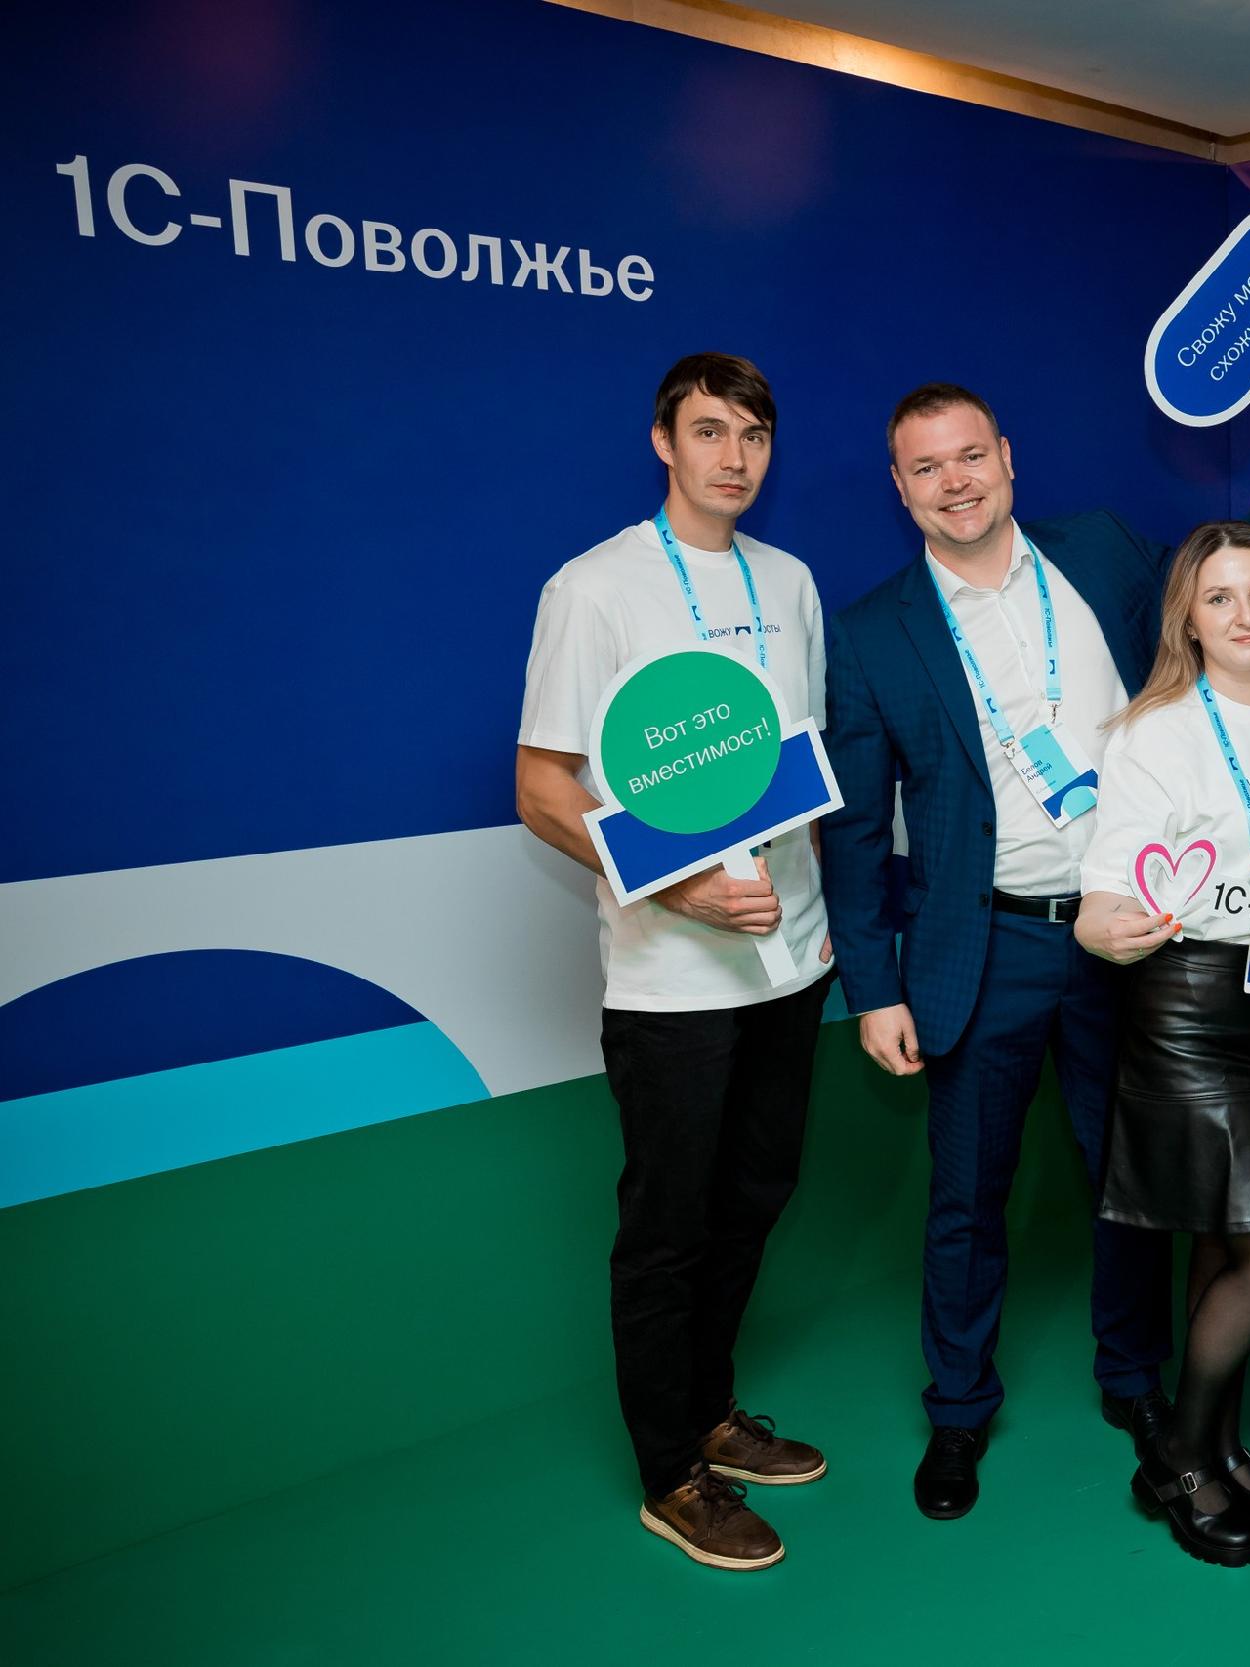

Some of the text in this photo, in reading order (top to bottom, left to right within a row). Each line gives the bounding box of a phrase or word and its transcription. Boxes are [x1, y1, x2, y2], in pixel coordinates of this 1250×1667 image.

[56, 154, 655, 302] 1С-Поволжье
[1177, 303, 1236, 367] Свожу
[708, 627, 731, 639] ВОЖУ
[628, 717, 771, 794] вместимост!
[644, 704, 730, 749] Вот это
